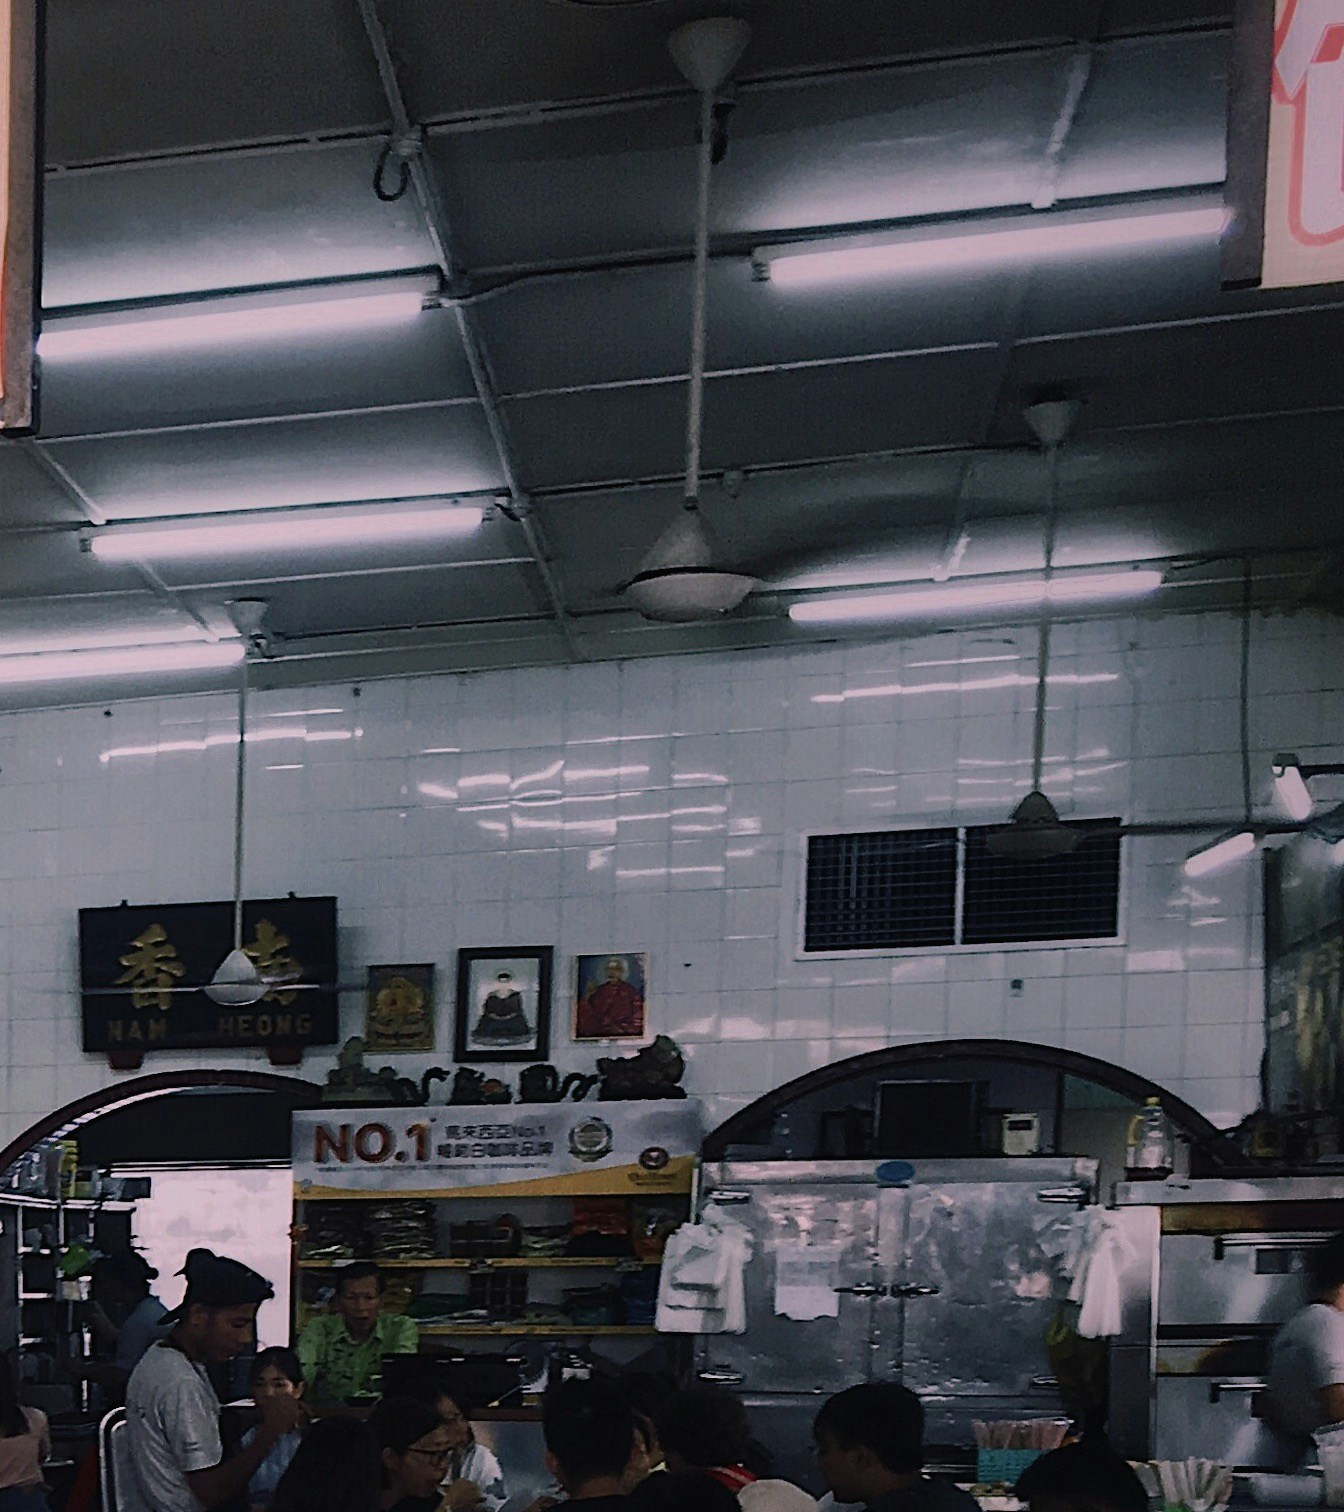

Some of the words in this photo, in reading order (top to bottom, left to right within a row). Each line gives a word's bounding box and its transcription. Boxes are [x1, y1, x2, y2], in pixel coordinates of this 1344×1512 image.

[107, 1017, 169, 1042] NAM
[217, 1013, 313, 1038] HEONG
[313, 1121, 431, 1165] NO.1
